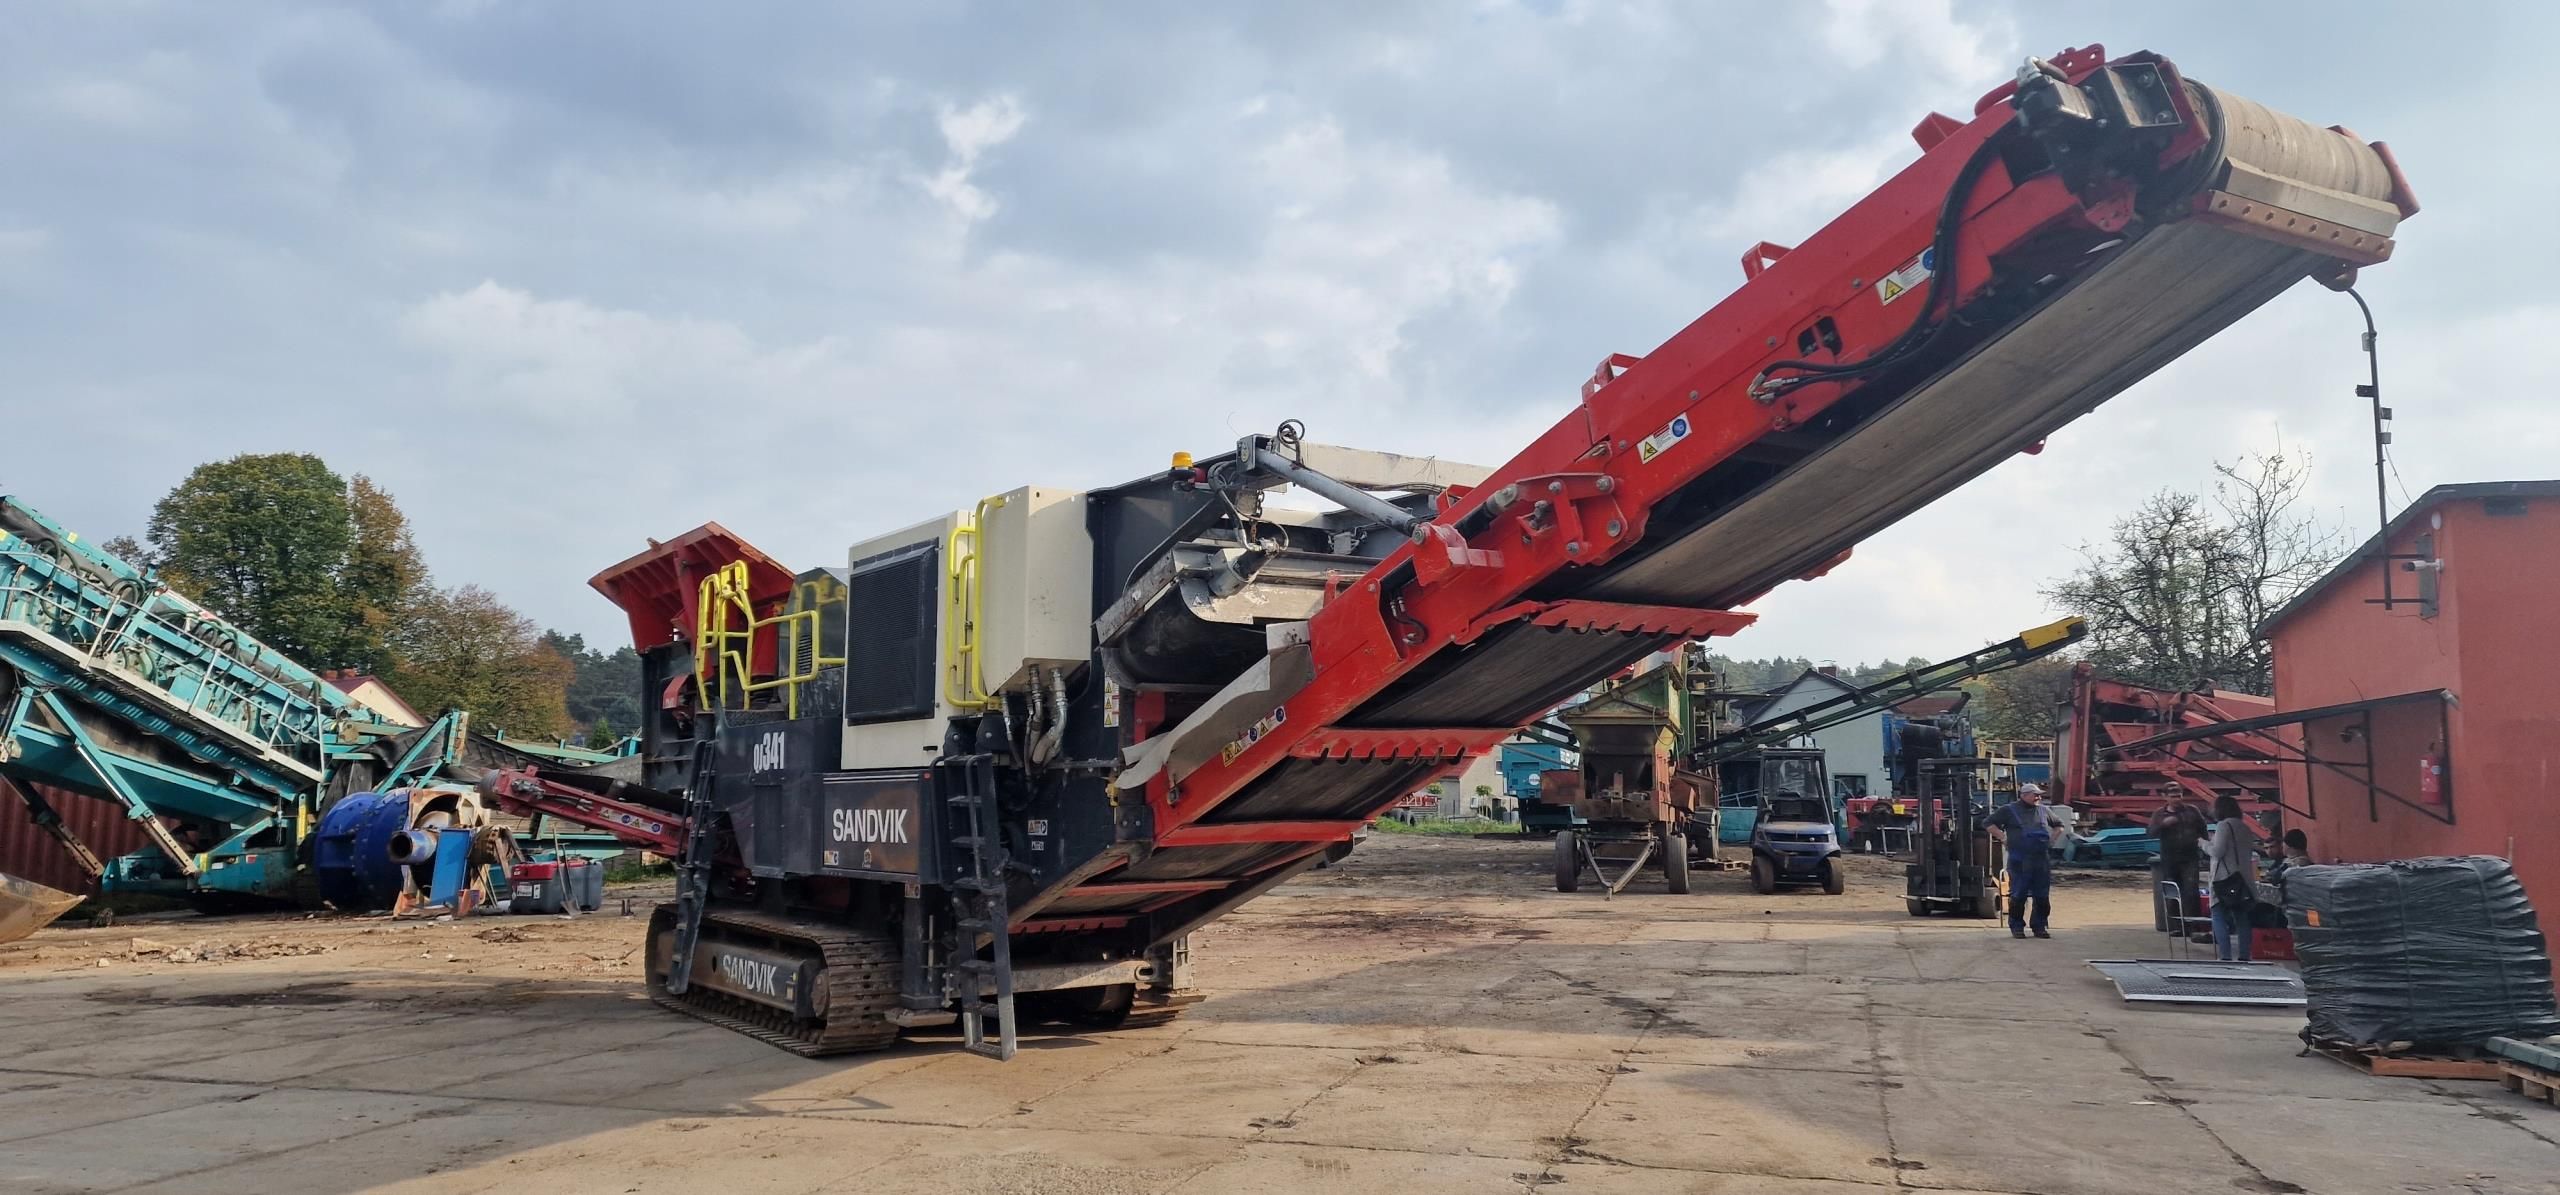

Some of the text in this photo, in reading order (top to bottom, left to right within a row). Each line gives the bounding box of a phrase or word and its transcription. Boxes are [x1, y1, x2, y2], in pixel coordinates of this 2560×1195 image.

[753, 731, 785, 774] QJ341
[832, 808, 908, 844] SANDVIK
[722, 954, 777, 997] SANDVIK
